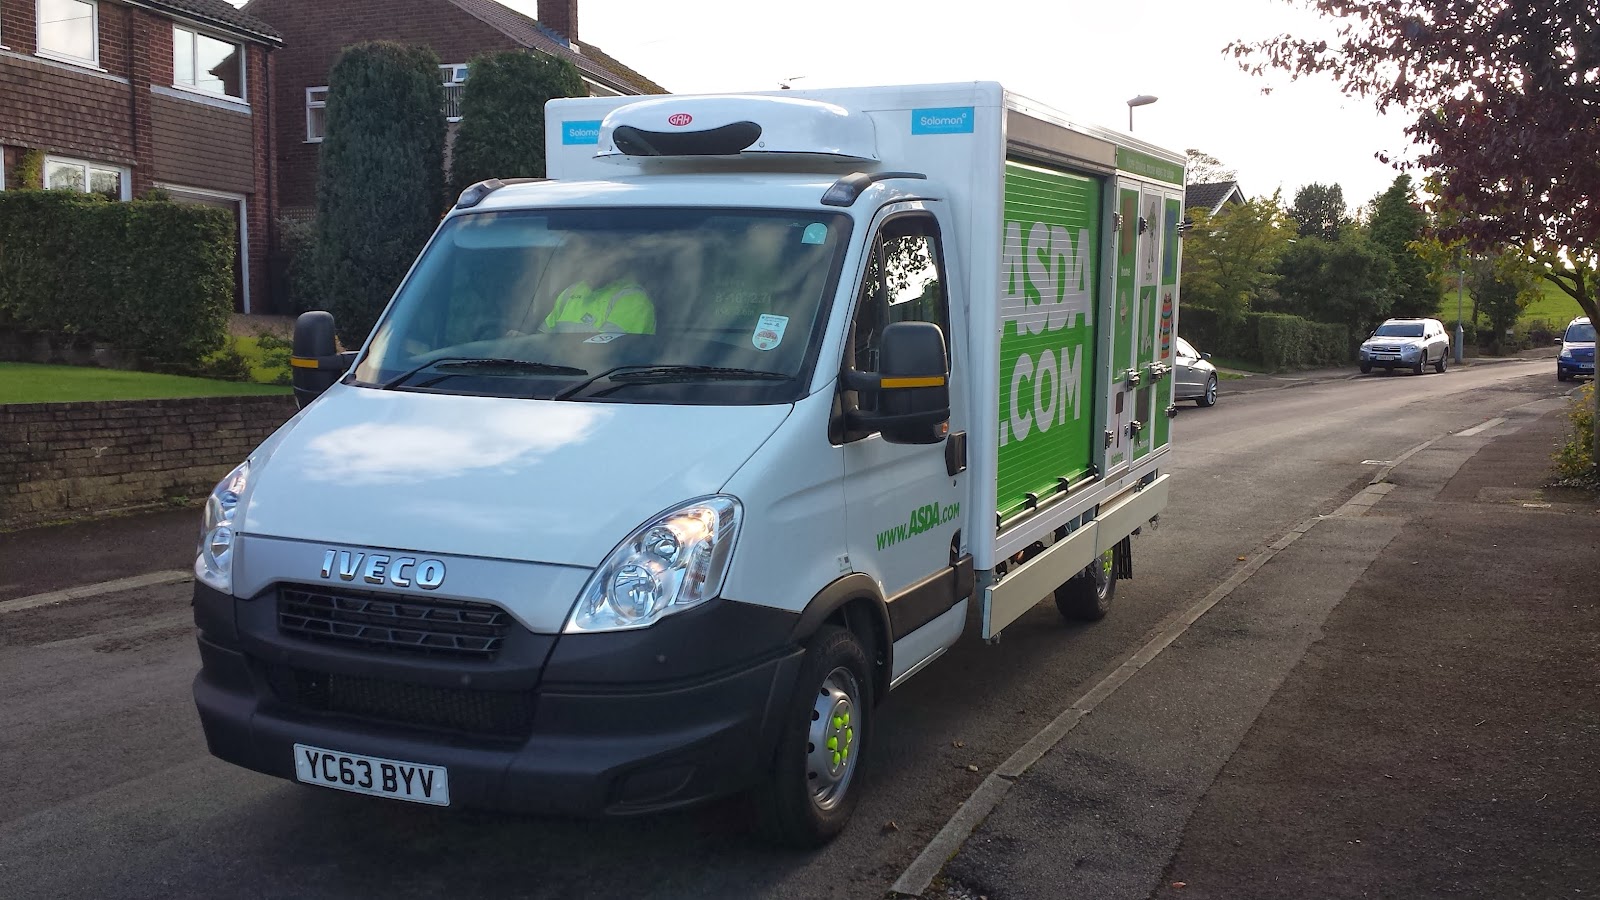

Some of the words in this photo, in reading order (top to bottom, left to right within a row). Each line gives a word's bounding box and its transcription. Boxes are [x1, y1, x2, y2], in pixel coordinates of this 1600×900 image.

[569, 128, 599, 137] Solomo
[670, 114, 690, 125] GAH
[1000, 221, 1093, 338] ASDA
[1000, 343, 1083, 448] .COM
[876, 501, 960, 551] WWW.ASDA.COM
[320, 549, 446, 590] IVECO
[305, 750, 373, 789] YC63
[380, 763, 434, 798] BYV
